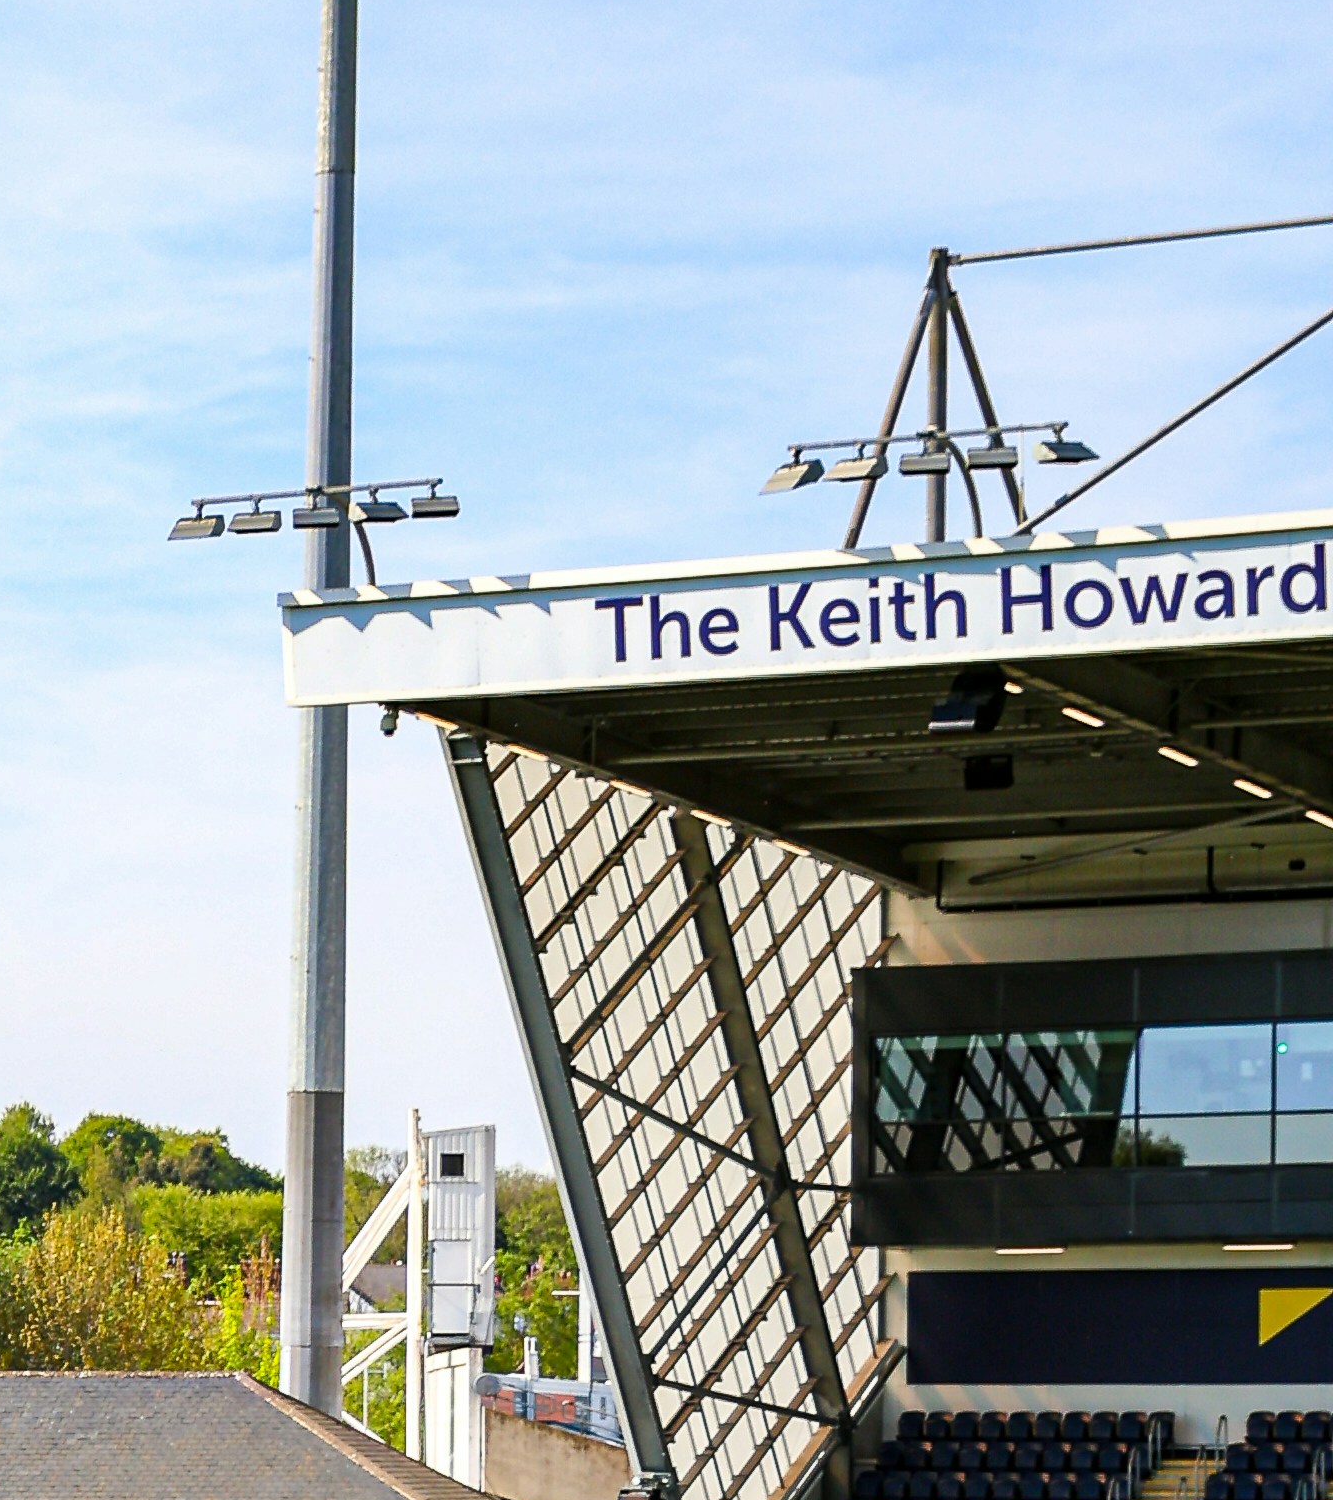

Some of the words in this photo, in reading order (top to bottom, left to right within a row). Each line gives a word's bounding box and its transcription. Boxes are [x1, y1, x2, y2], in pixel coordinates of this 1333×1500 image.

[595, 595, 739, 662] The
[769, 573, 967, 651] Keith
[1001, 542, 1326, 634] Howard
